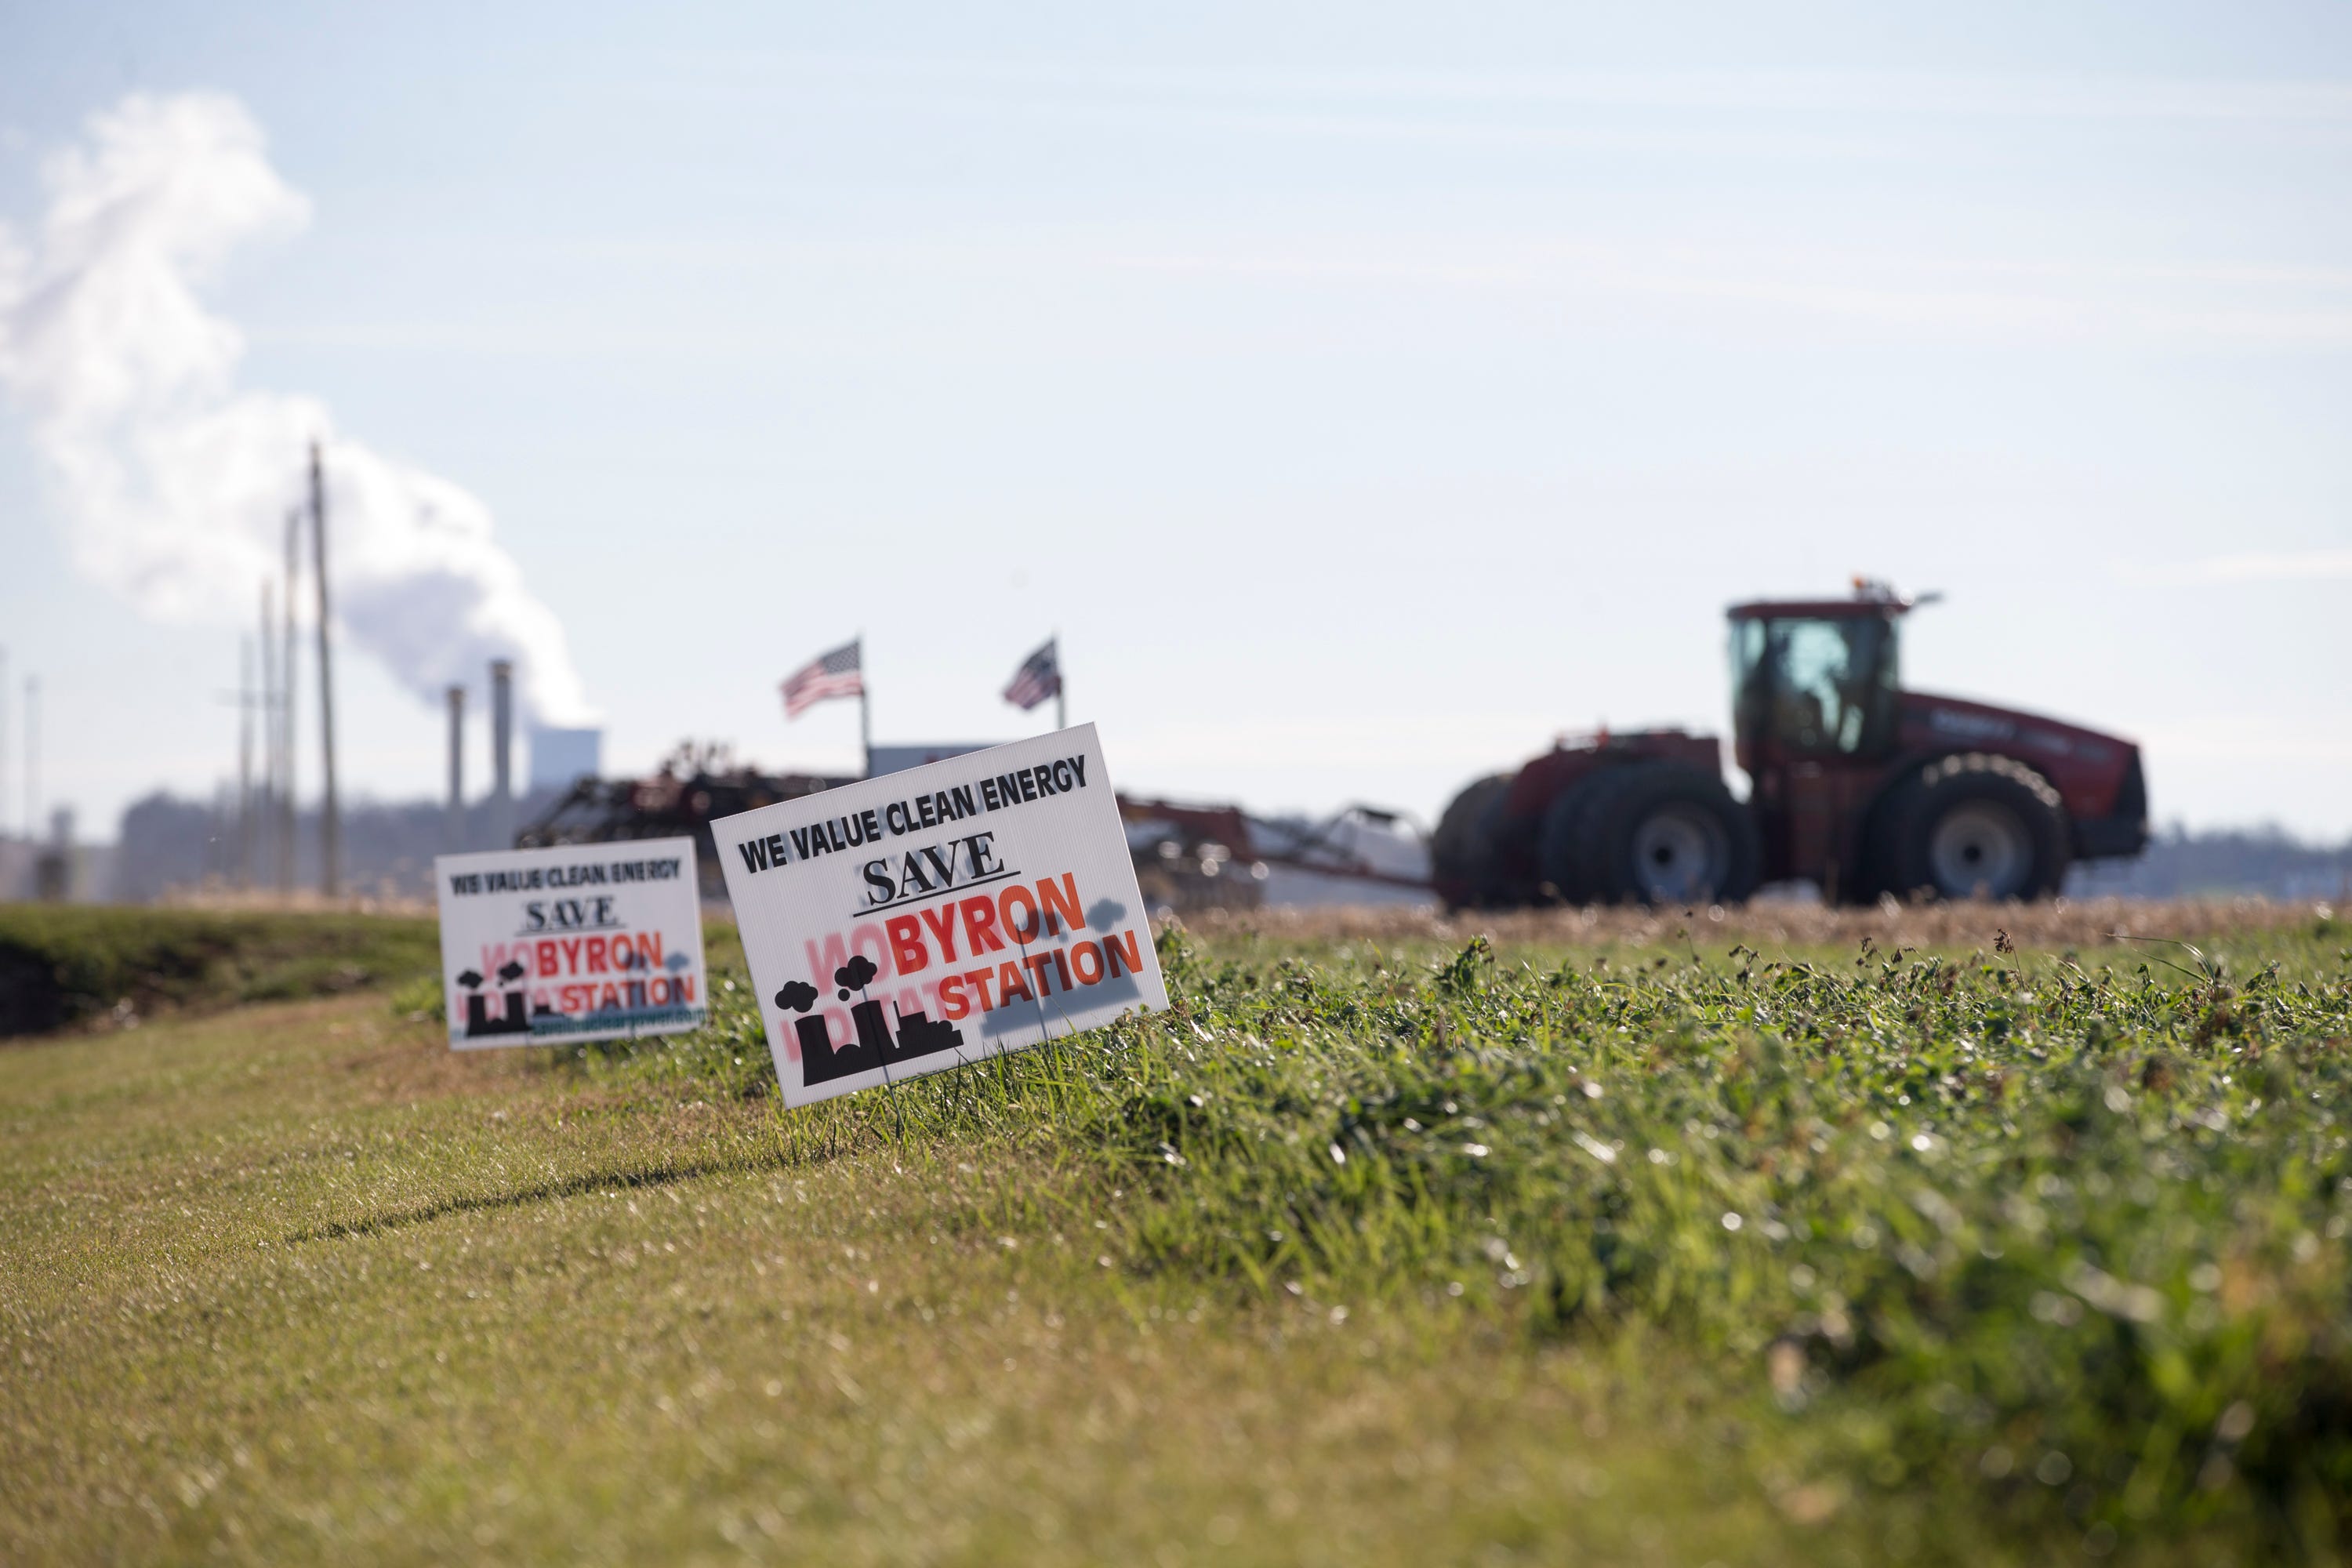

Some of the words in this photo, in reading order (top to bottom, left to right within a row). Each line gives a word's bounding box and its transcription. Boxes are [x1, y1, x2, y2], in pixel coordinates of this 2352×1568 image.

[738, 835, 787, 873] WE
[789, 809, 881, 860] VALUE
[886, 785, 977, 835] CLEAN
[979, 755, 1087, 812] ENERGY
[451, 873, 480, 895] WE
[484, 869, 541, 892] VALUE
[548, 863, 606, 887] CLEAN
[612, 859, 681, 882] ENERGY
[862, 832, 1005, 906] SAVE
[526, 896, 617, 927] SAVE
[884, 872, 1087, 976] BYRON
[537, 931, 663, 978] BYRON
[939, 930, 1143, 1021] STATION
[561, 975, 695, 1012] STATION
